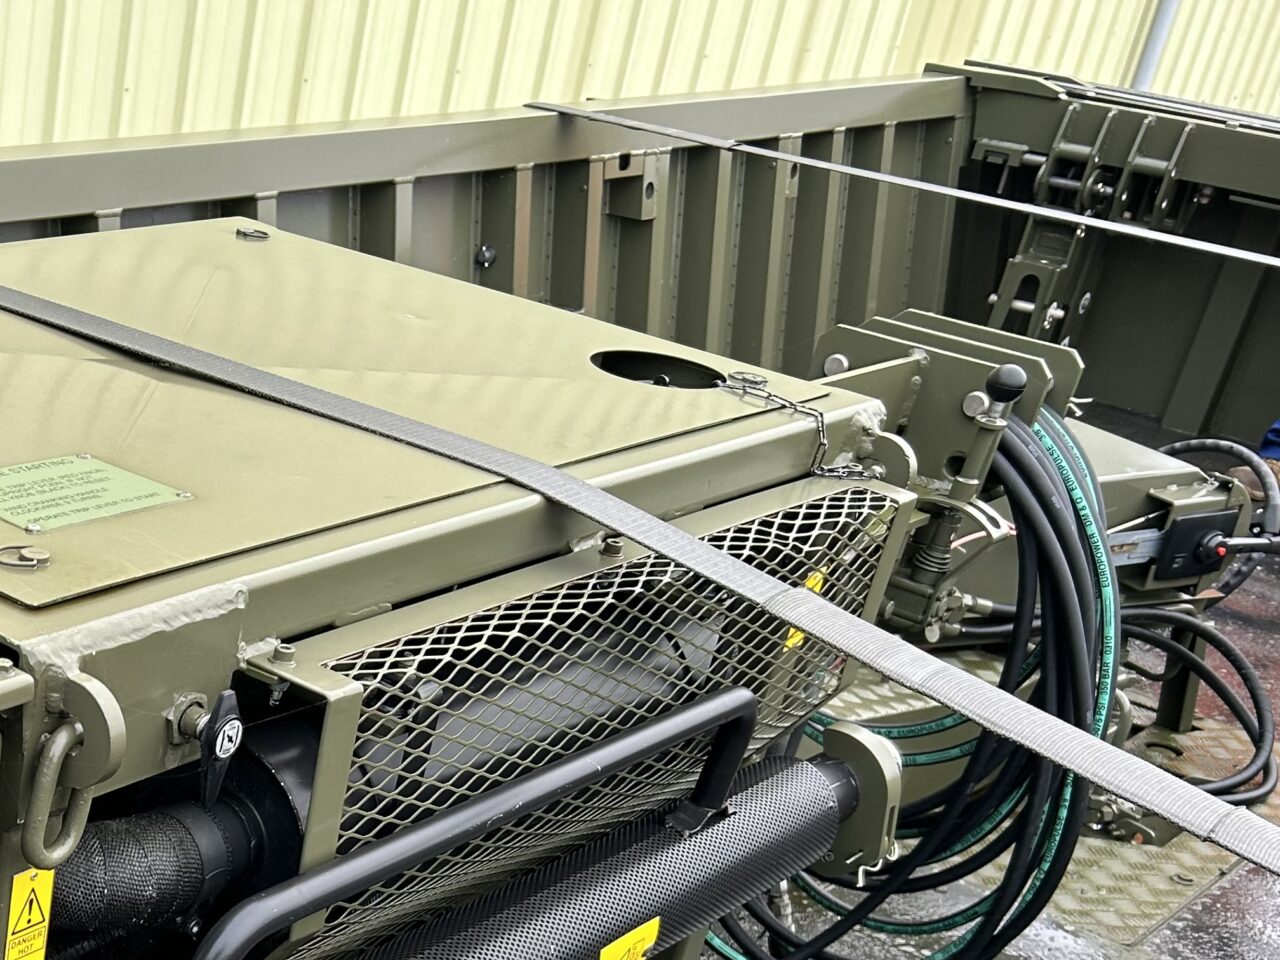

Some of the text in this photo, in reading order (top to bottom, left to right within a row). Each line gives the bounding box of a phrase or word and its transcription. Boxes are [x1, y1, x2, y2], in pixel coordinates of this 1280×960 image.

[8, 459, 73, 473] STARTING
[1046, 444, 1078, 492] EUROPULSE
[1089, 532, 1110, 588] EUROPOWER
[1102, 661, 1111, 680] BAR
[1100, 682, 1109, 696] 350
[1097, 702, 1106, 717] PSI
[11, 930, 43, 949] DANGER
[17, 943, 34, 956] HOT
